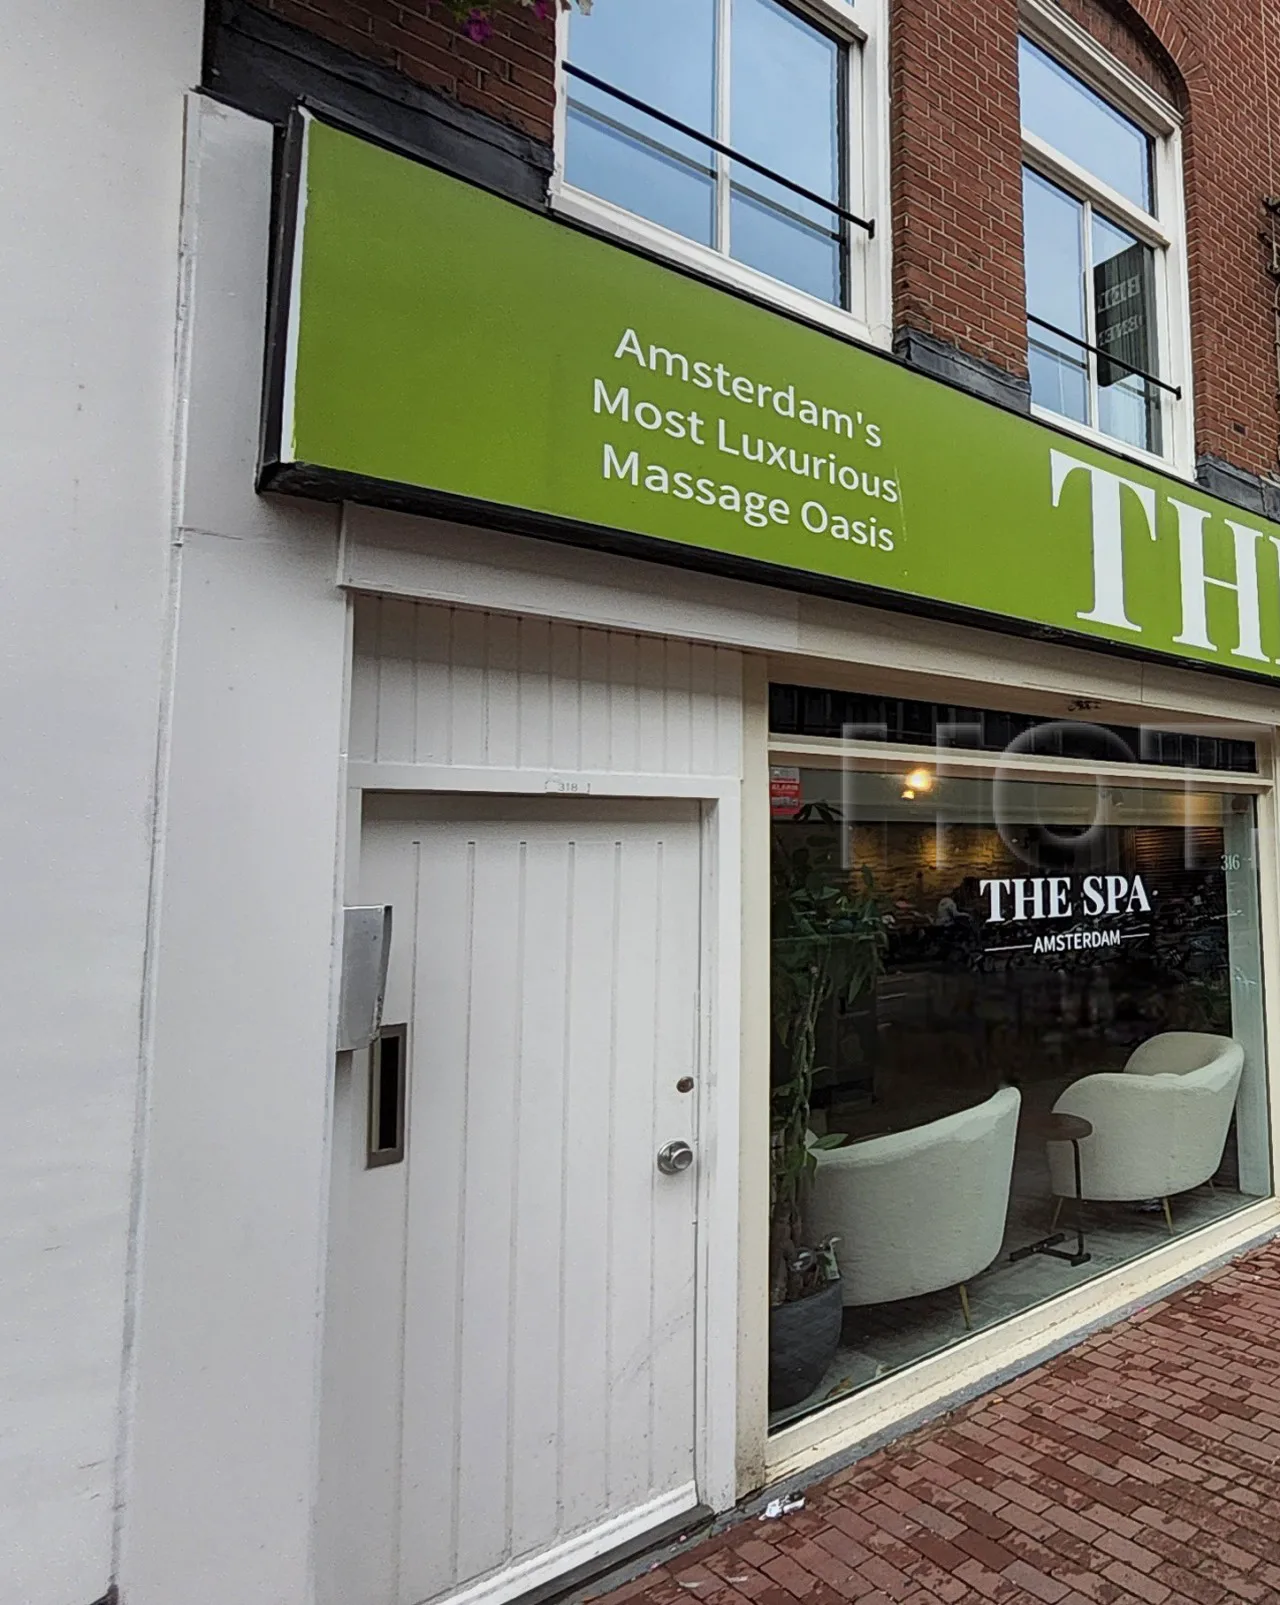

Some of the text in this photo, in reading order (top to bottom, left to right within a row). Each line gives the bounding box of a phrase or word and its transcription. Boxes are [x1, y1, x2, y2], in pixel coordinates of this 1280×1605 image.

[613, 328, 882, 448] Amsterdam's
[592, 378, 899, 504] Most Luxurious
[602, 443, 896, 552] Massage Oasis
[558, 783, 579, 792] 318
[1220, 854, 1240, 871] 316
[979, 875, 1152, 923] THE SPA
[1033, 929, 1121, 954] AMSTERDAM
